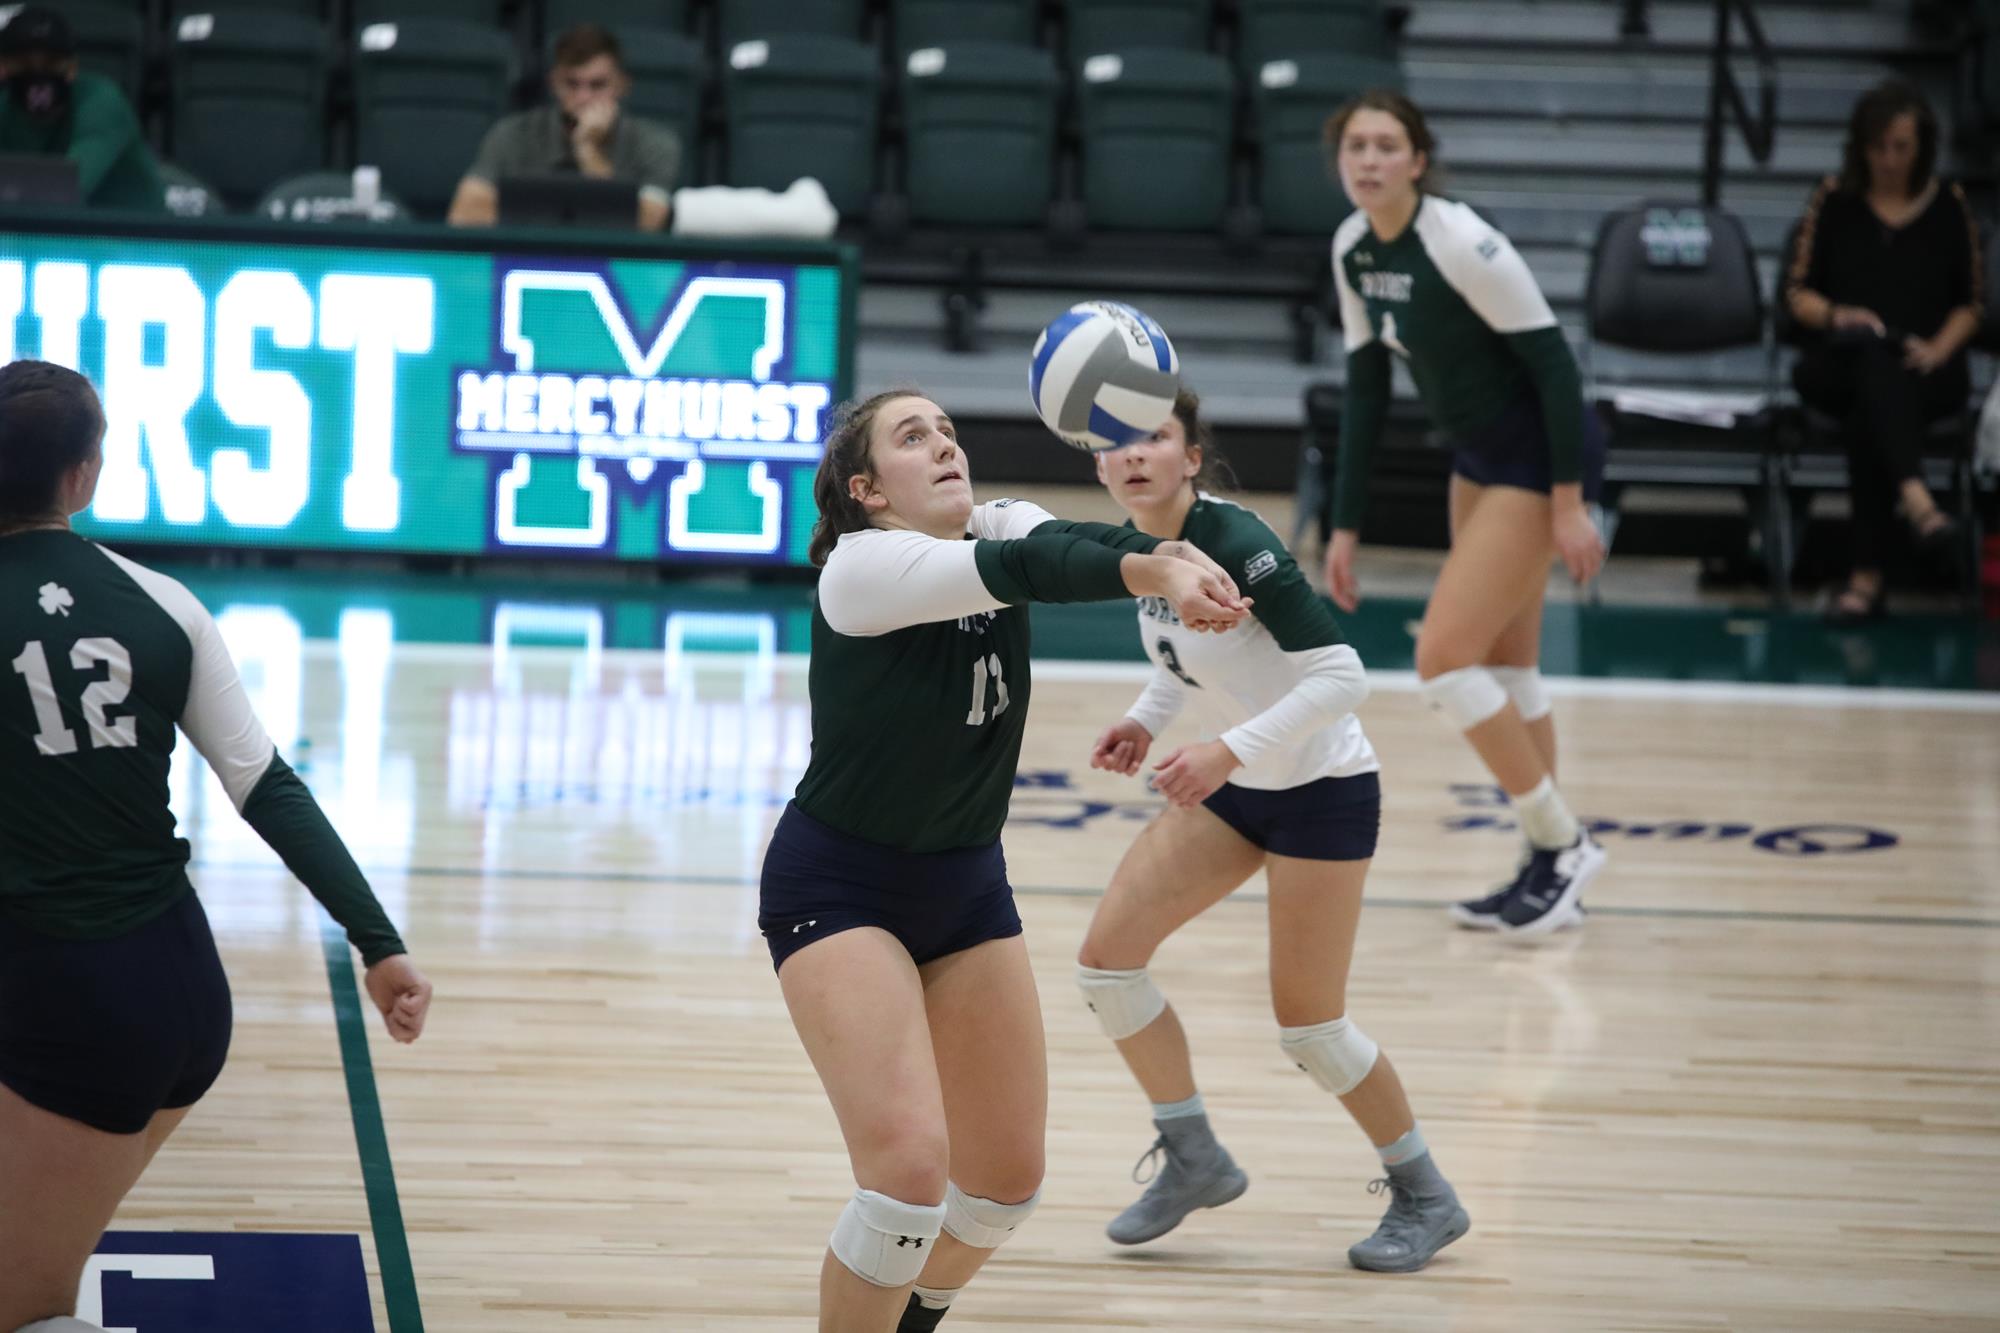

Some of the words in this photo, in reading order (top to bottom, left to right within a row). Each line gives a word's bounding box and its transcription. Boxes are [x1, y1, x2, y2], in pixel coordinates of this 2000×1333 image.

[457, 370, 831, 443] MERCYHURST
[12, 637, 138, 756] 12
[966, 652, 1010, 727] 13
[1156, 636, 1205, 690] 2
